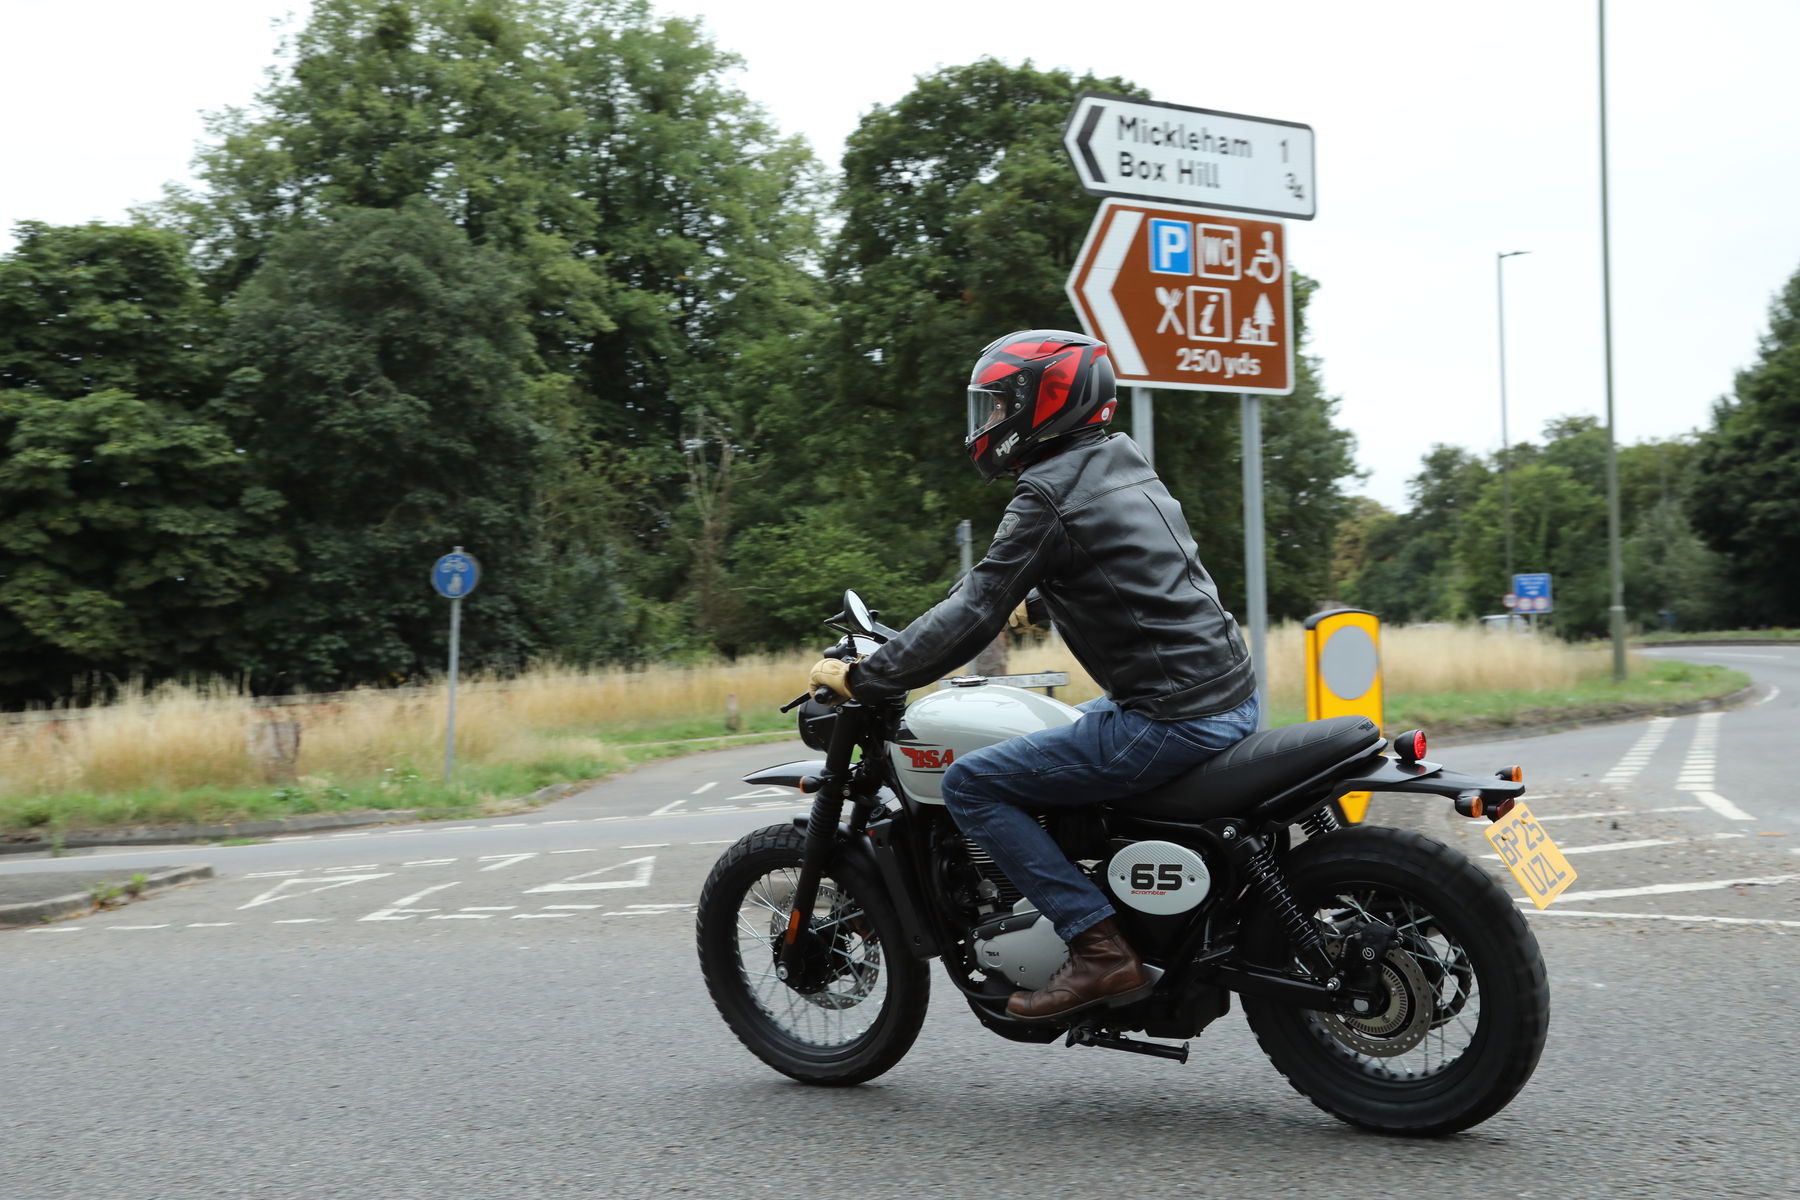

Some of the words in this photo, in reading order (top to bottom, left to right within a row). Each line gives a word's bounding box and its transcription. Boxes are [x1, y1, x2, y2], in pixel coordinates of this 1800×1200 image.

[1118, 115, 1252, 157] Mickleham
[1280, 139, 1290, 164] 1
[1118, 151, 1167, 183] Box
[1177, 158, 1221, 189] Hill
[1159, 225, 1188, 269] P
[1203, 236, 1235, 266] WC
[1176, 348, 1222, 373] 250
[1224, 352, 1262, 379] yds
[900, 747, 954, 768] BSA
[1492, 811, 1545, 867] BP25
[1130, 863, 1183, 891] 65
[1521, 852, 1566, 895] UZL
